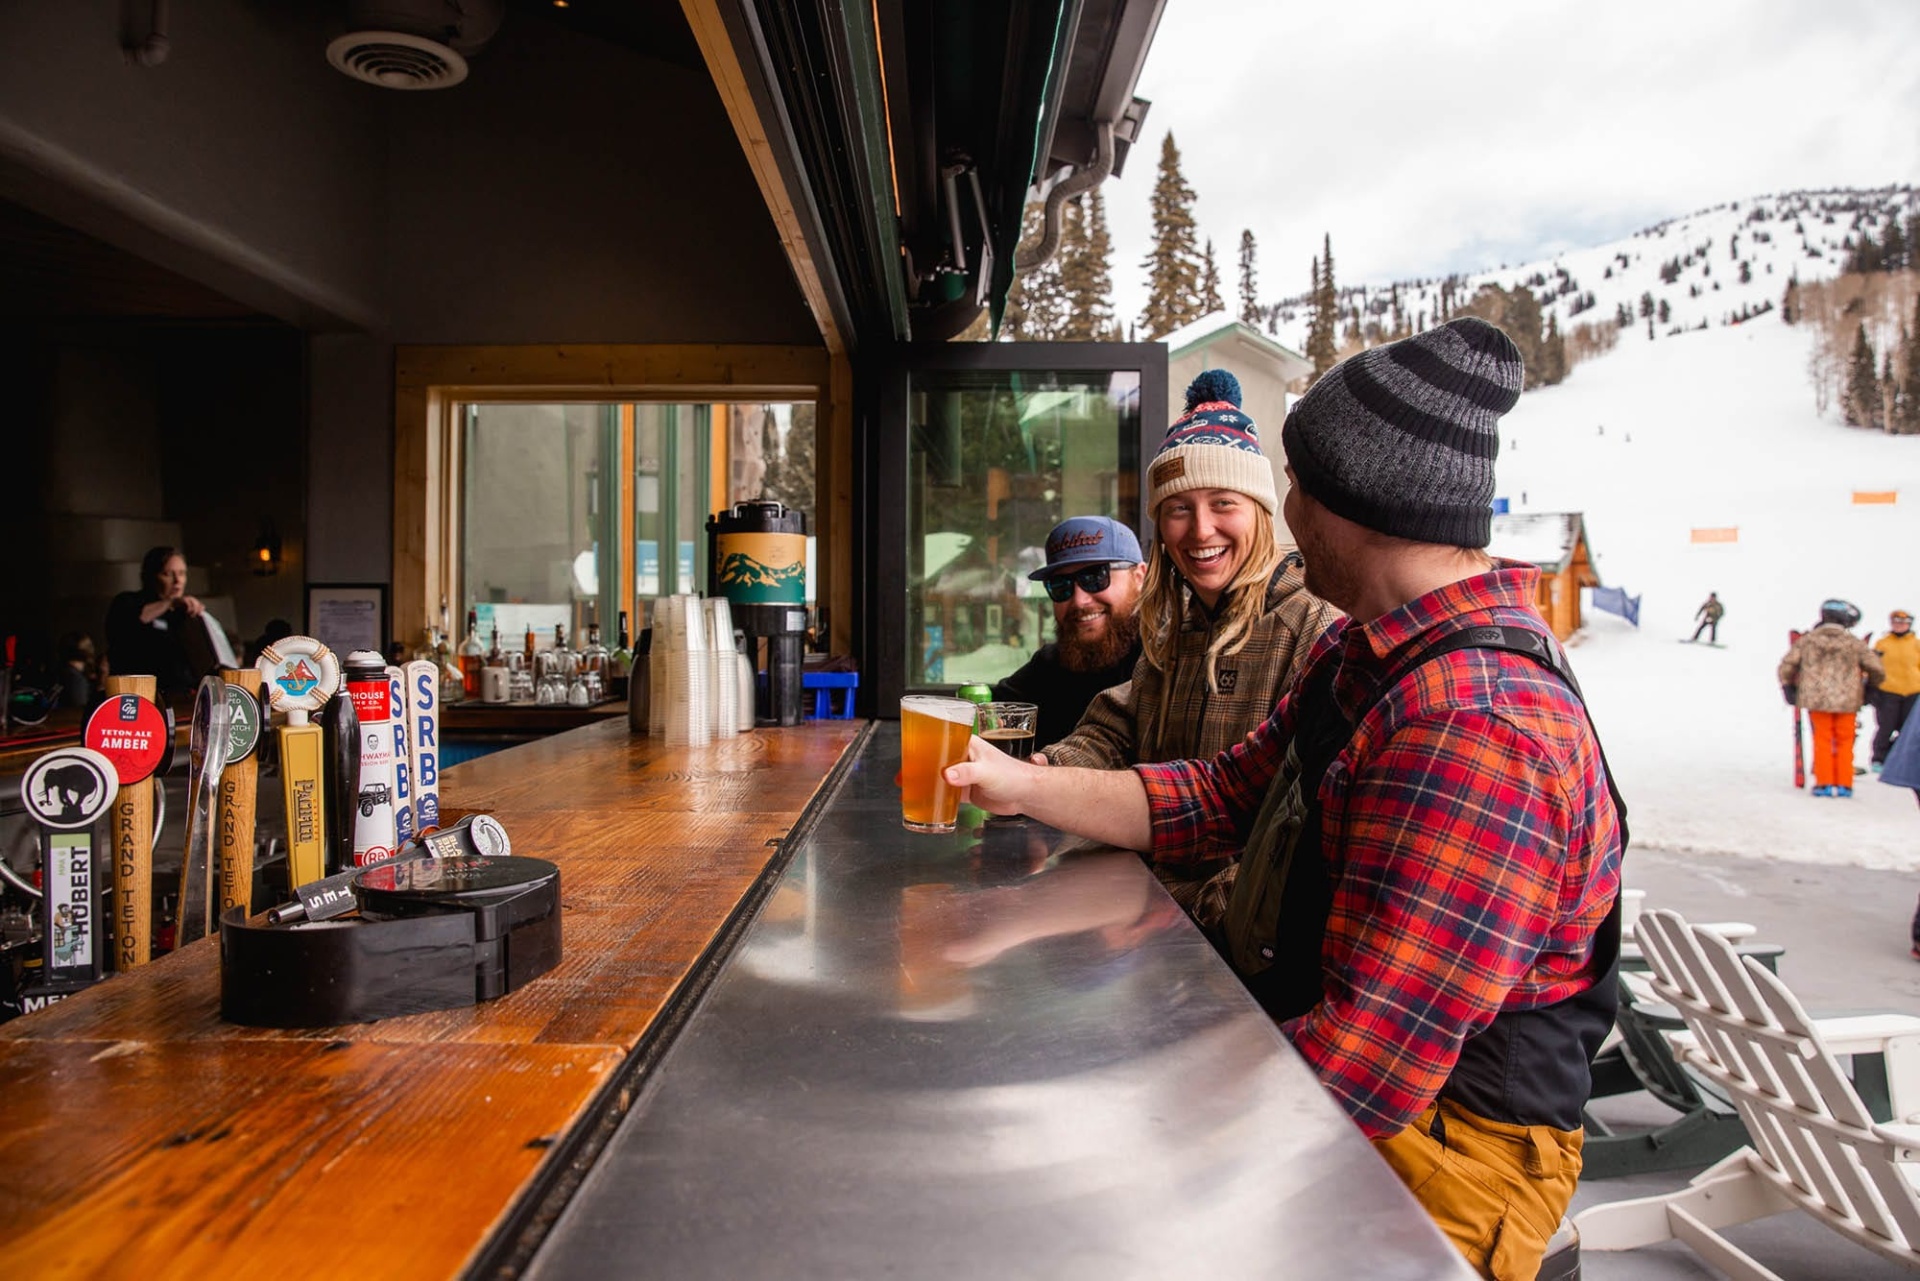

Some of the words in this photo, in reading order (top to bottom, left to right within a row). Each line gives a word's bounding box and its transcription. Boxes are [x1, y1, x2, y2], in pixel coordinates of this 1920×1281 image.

[101, 729, 133, 738] TETON
[135, 731, 152, 739] ALE
[101, 738, 148, 749] AMBER
[417, 674, 437, 787] SRB
[120, 803, 135, 877] GRAND
[224, 781, 235, 847] GRAND
[71, 846, 89, 935] HUBERT
[121, 890, 136, 964] TETON
[24, 995, 67, 1015] ME
